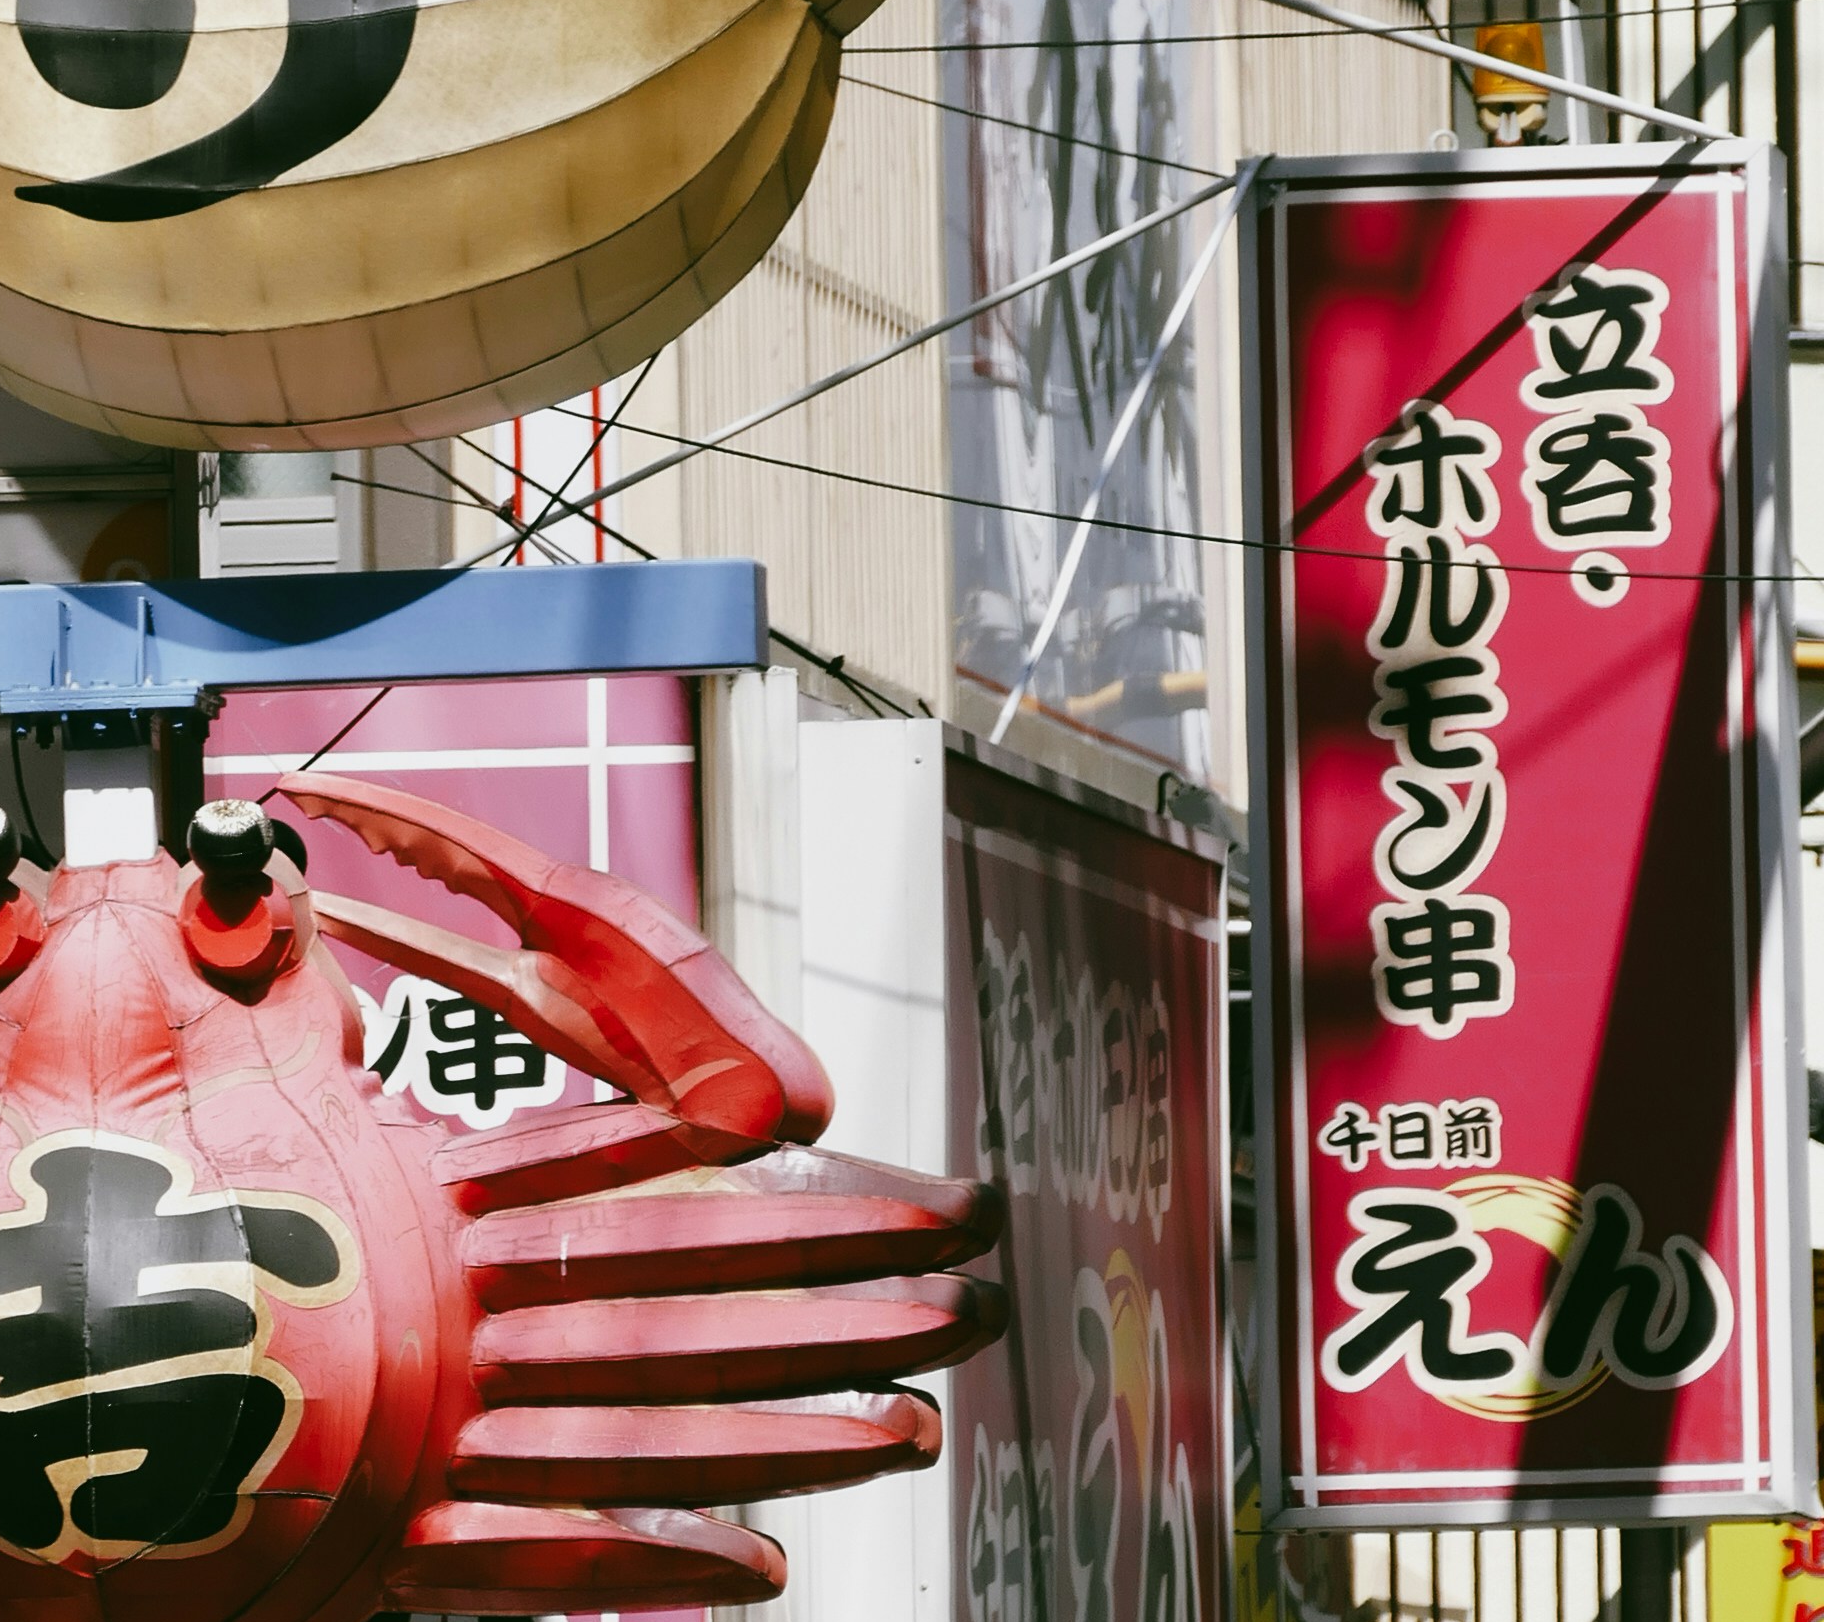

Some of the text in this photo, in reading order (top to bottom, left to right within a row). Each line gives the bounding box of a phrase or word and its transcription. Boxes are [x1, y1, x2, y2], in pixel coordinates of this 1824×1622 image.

[1372, 407, 1507, 1031] ホルモン串
[1323, 1103, 1497, 1167] 千日前
[1330, 1189, 1726, 1385] えん
